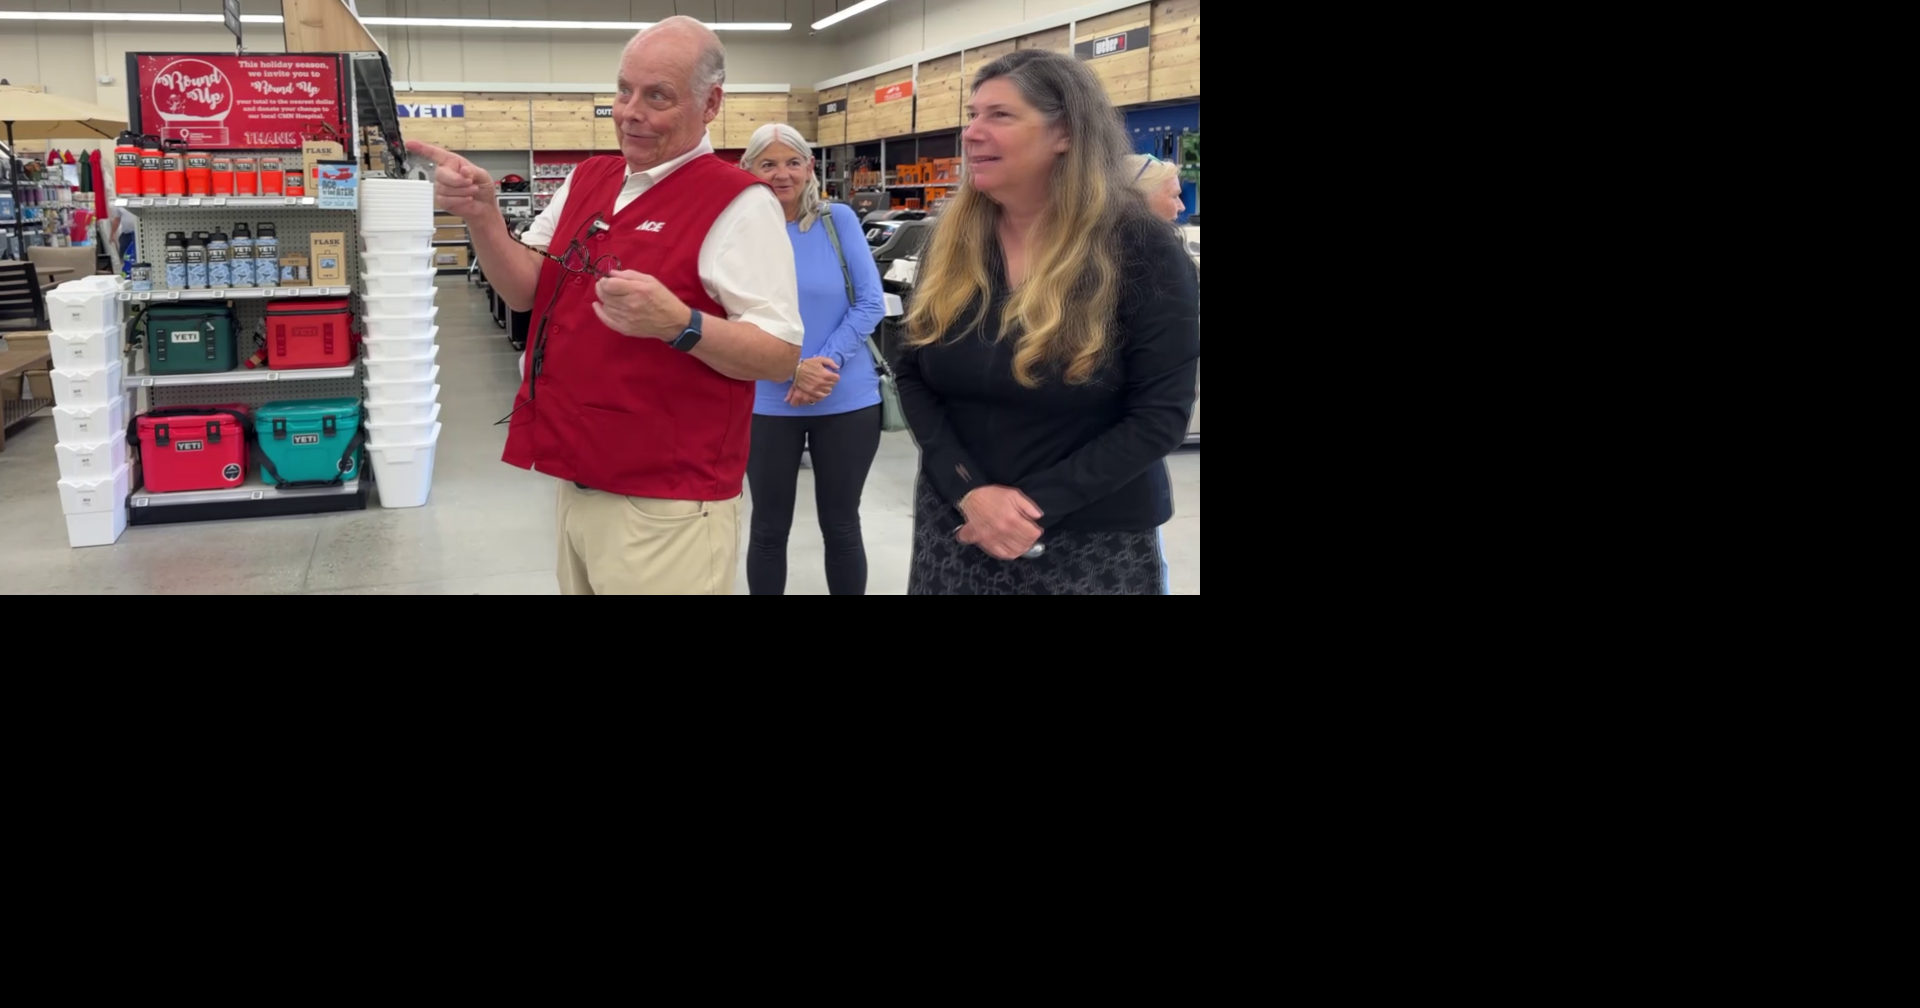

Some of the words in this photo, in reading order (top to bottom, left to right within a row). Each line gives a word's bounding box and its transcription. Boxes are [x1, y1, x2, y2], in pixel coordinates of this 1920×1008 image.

[260, 61, 293, 70] holiday
[155, 67, 222, 92] Round
[292, 71, 309, 79] you
[251, 80, 294, 95] Round
[296, 81, 321, 97] Up
[186, 87, 225, 110] Up
[403, 104, 452, 118] YETI
[244, 131, 297, 145] THANK
[634, 219, 666, 233] ACE
[174, 333, 198, 341] YETI
[177, 443, 201, 451] YETI
